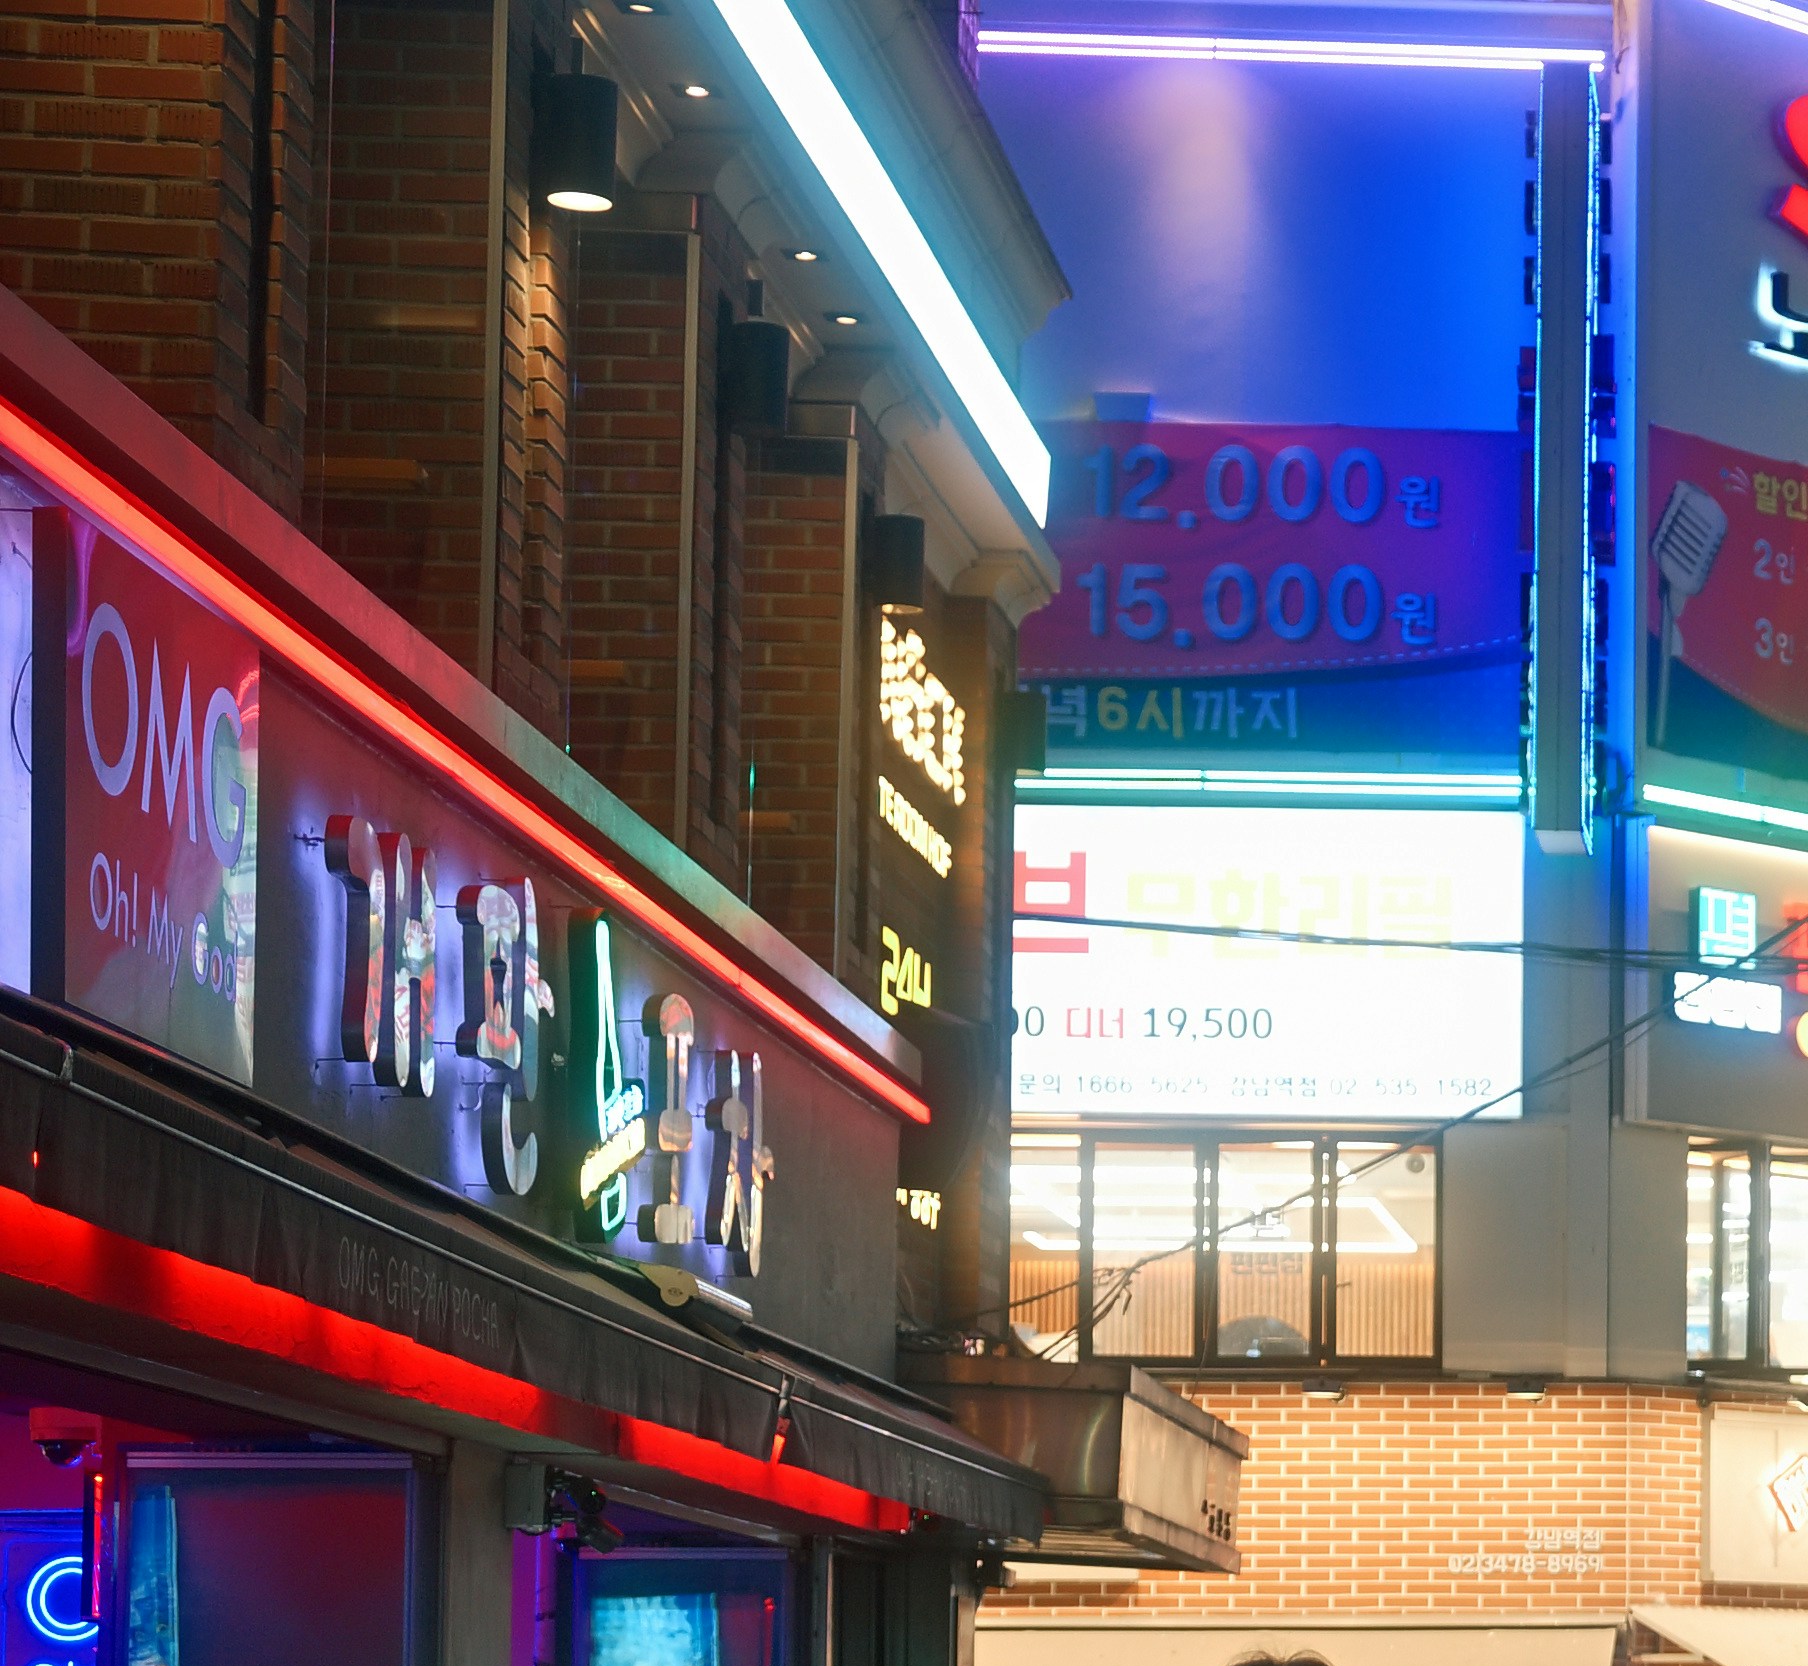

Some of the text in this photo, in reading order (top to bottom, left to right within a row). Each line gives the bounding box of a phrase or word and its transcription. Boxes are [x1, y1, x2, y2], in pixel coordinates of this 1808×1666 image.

[82, 603, 246, 868] OMG
[90, 852, 239, 1002] Oh! My God
[1066, 1007, 1273, 1042] 디너 19,500
